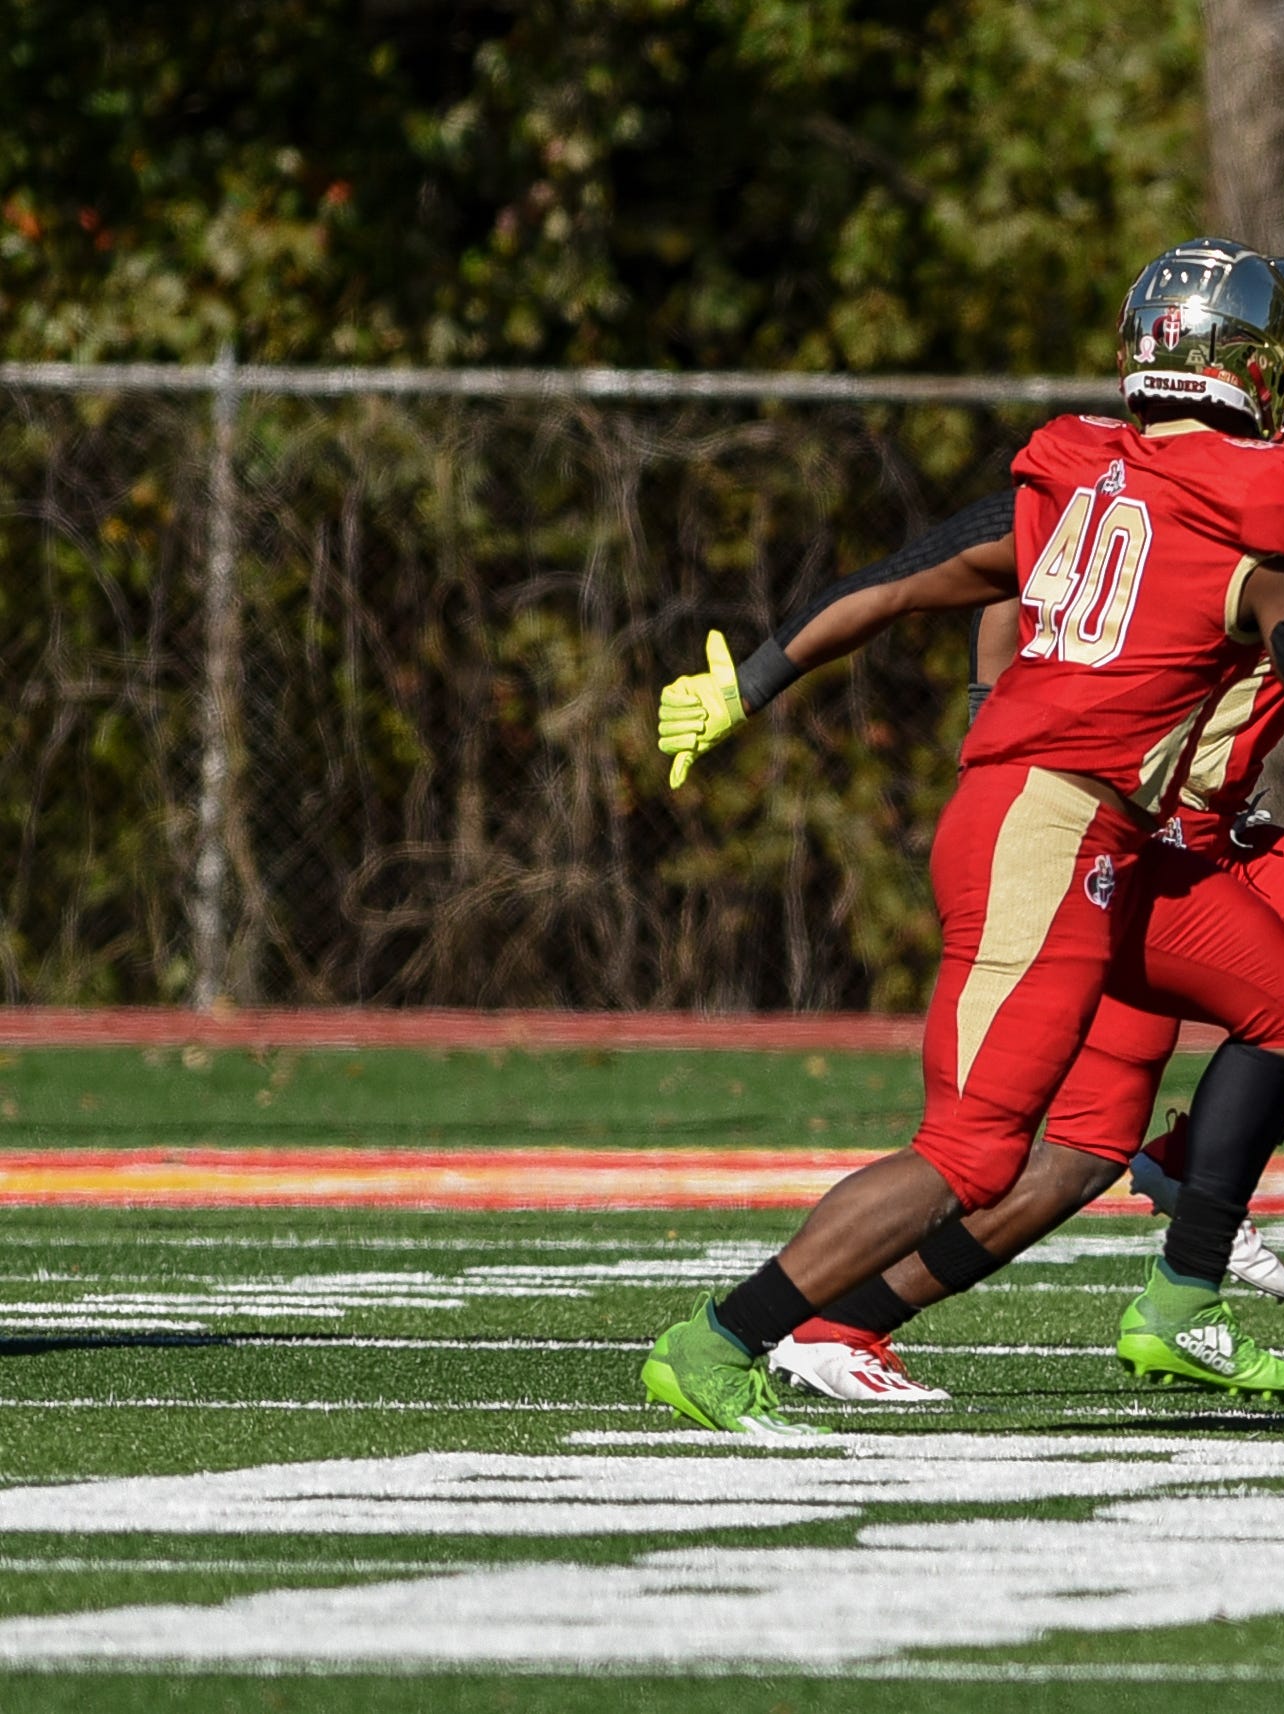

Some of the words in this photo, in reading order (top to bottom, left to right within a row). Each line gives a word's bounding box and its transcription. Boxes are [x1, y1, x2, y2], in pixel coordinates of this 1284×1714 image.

[1144, 375, 1207, 394] CRUSADERS
[1021, 486, 1153, 668] 40
[1175, 1332, 1235, 1375] adidas
